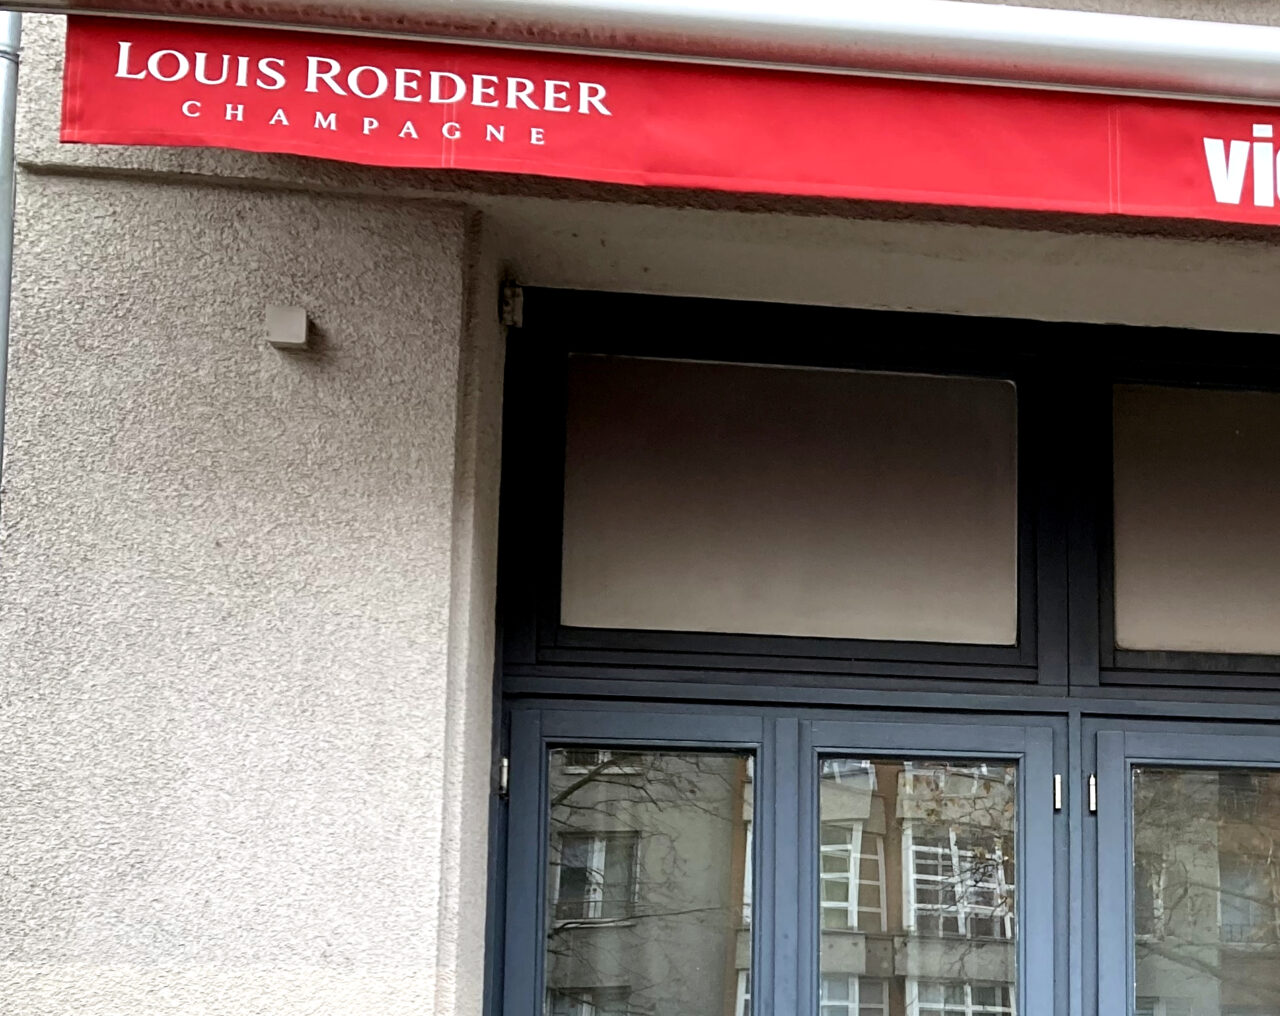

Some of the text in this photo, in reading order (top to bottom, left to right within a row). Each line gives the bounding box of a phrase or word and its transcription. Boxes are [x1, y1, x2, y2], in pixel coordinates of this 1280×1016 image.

[115, 41, 613, 117] LOUIS ROEDERER
[181, 100, 546, 146] CHAMPAGNE
